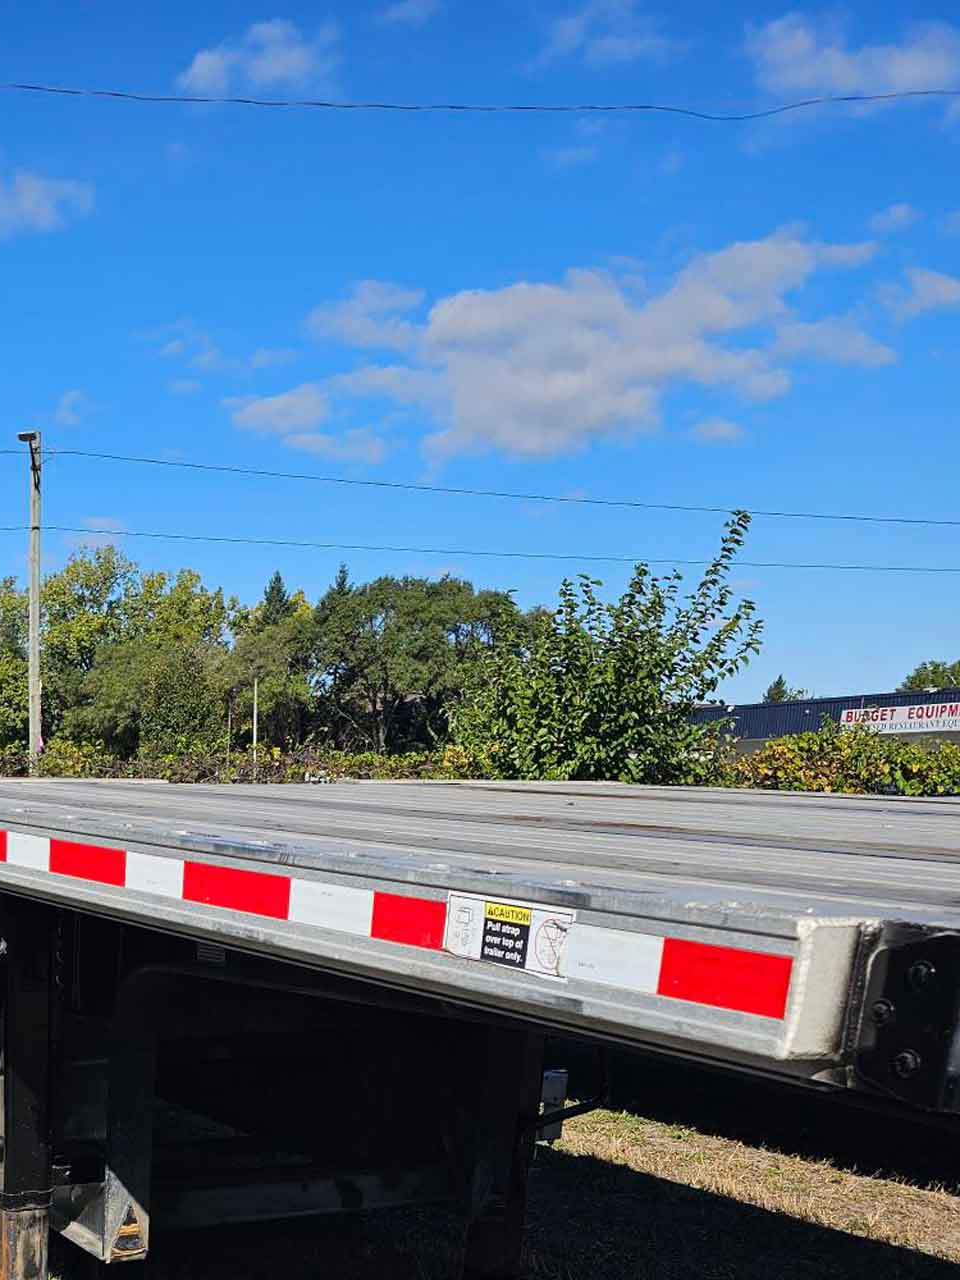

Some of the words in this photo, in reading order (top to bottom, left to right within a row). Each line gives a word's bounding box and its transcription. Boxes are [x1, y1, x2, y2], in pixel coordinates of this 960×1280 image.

[494, 906, 529, 921] CAUTION
[486, 921, 501, 932] Pull
[501, 924, 520, 937] strap
[485, 935, 501, 944] over
[502, 937, 514, 949] top
[515, 939, 524, 949] of
[484, 945, 505, 958] trailer
[505, 951, 522, 964] only.
